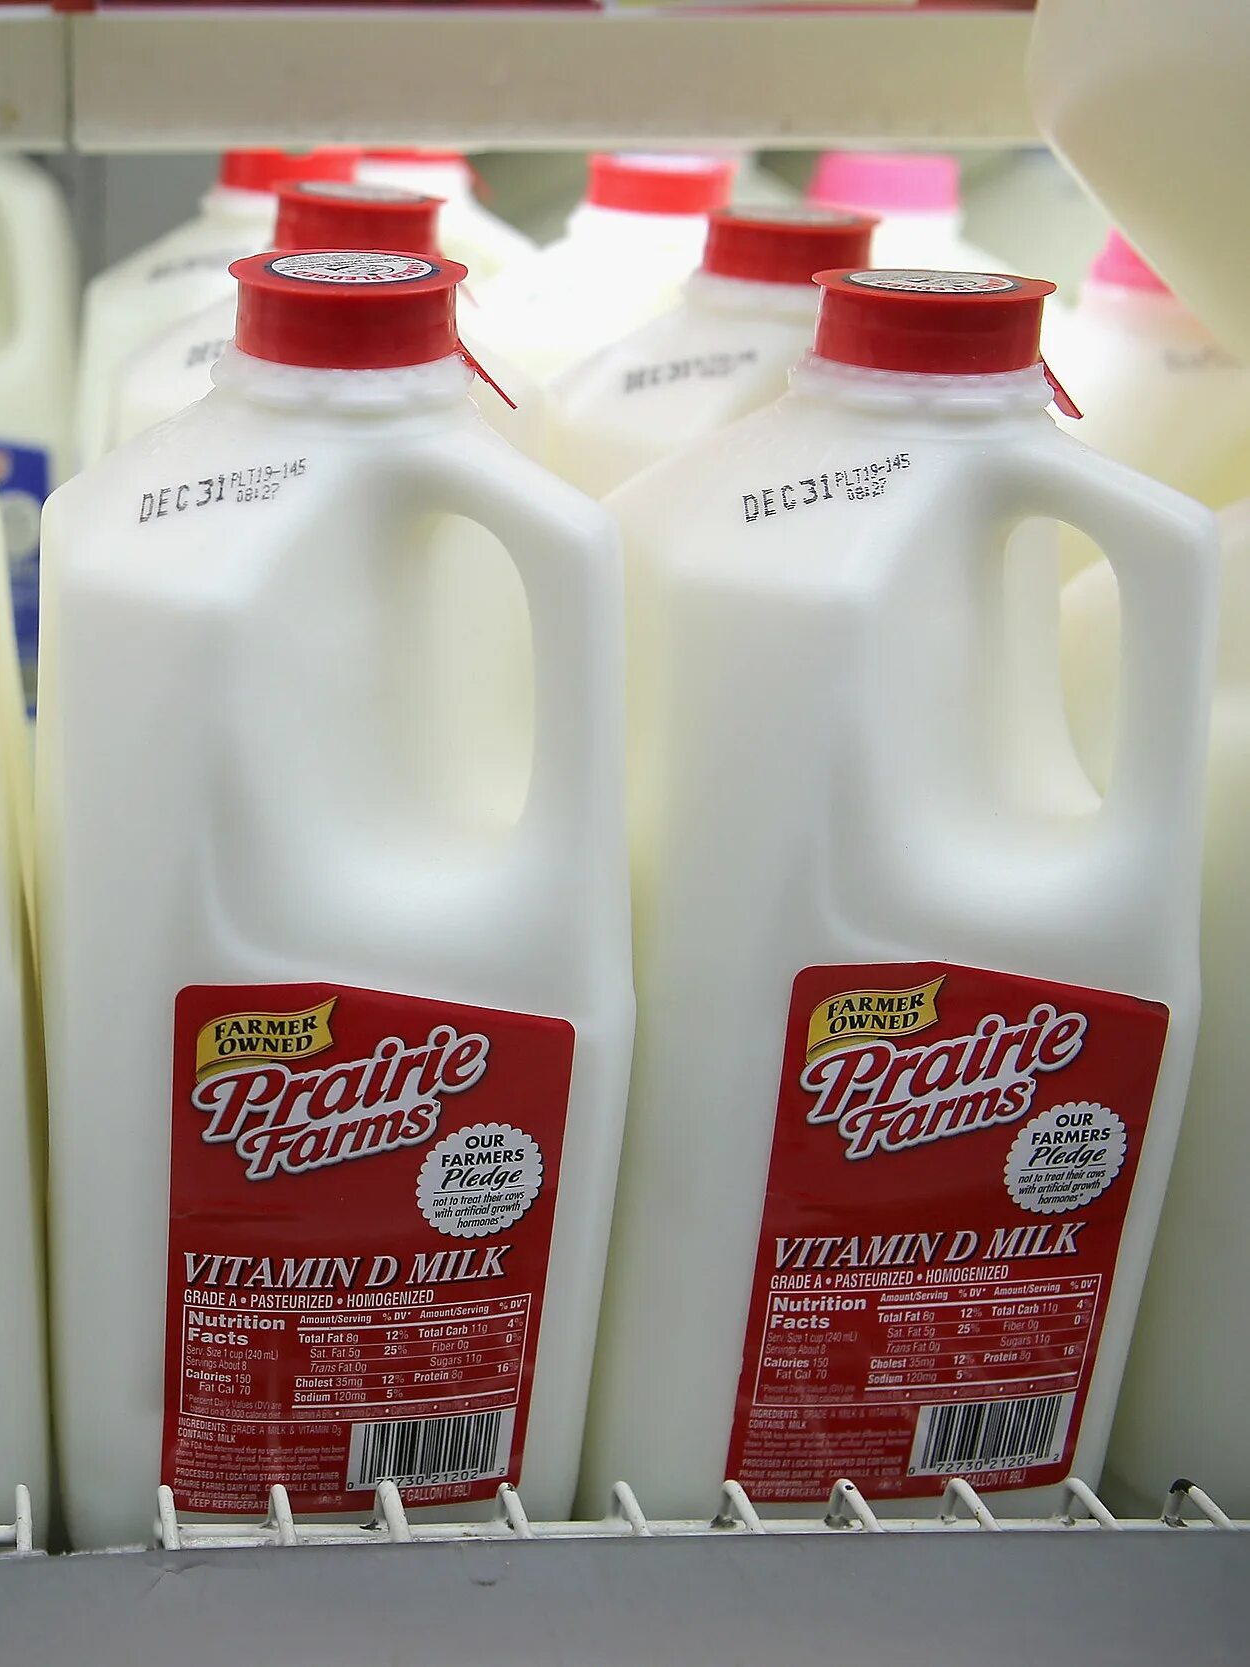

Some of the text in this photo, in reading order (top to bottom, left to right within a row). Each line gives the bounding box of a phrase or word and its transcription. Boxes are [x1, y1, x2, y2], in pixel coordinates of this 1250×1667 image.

[827, 993, 925, 1020] FARMER
[215, 1016, 318, 1040] FARMER
[830, 1012, 919, 1035] OWNED
[219, 1035, 312, 1056] OWNED
[807, 1010, 1080, 1117] Prairie
[200, 1031, 483, 1136] Prairie
[845, 1082, 1029, 1153] Farms
[1056, 1113, 1093, 1127] OUR
[245, 1104, 434, 1174] Farms
[465, 1134, 504, 1149] OUR
[1032, 1128, 1110, 1145] FARMERS
[442, 1149, 524, 1167] FARMERS
[1029, 1144, 1106, 1168] Pledge
[441, 1165, 522, 1191] Pledge
[1018, 1170, 1106, 1183] not to treat their cows
[1019, 1179, 1100, 1194] with artificial growth
[433, 1191, 525, 1207] not to treat their cows
[435, 1201, 520, 1218] with artificial growth
[774, 1222, 1086, 1271] VITAMIN D MILK
[184, 1245, 511, 1288] VITAMIN D MILK
[771, 1266, 1009, 1289] GRADE A PASTEURIZED HOMOGENIZED
[184, 1289, 434, 1309] GRADE A PASTEURIZED HOMOGENIZED
[772, 1296, 866, 1311] Nutrition
[189, 1311, 285, 1330] Nutrition
[770, 1314, 830, 1329] Facts
[188, 1327, 249, 1345] Facts
[299, 1331, 408, 1345] Total Fat 8g 12%
[418, 1324, 487, 1338] Total Carb 11g
[186, 1369, 251, 1383] Calories 150
[296, 1377, 362, 1389] Cholest 35mg
[414, 1371, 448, 1382] Protein
[294, 1391, 366, 1402] Sodium 120mg
[937, 1461, 982, 1473] 72730
[990, 1456, 1034, 1469] 21202
[1053, 1453, 1059, 1461] 2
[432, 1470, 478, 1483] 21202
